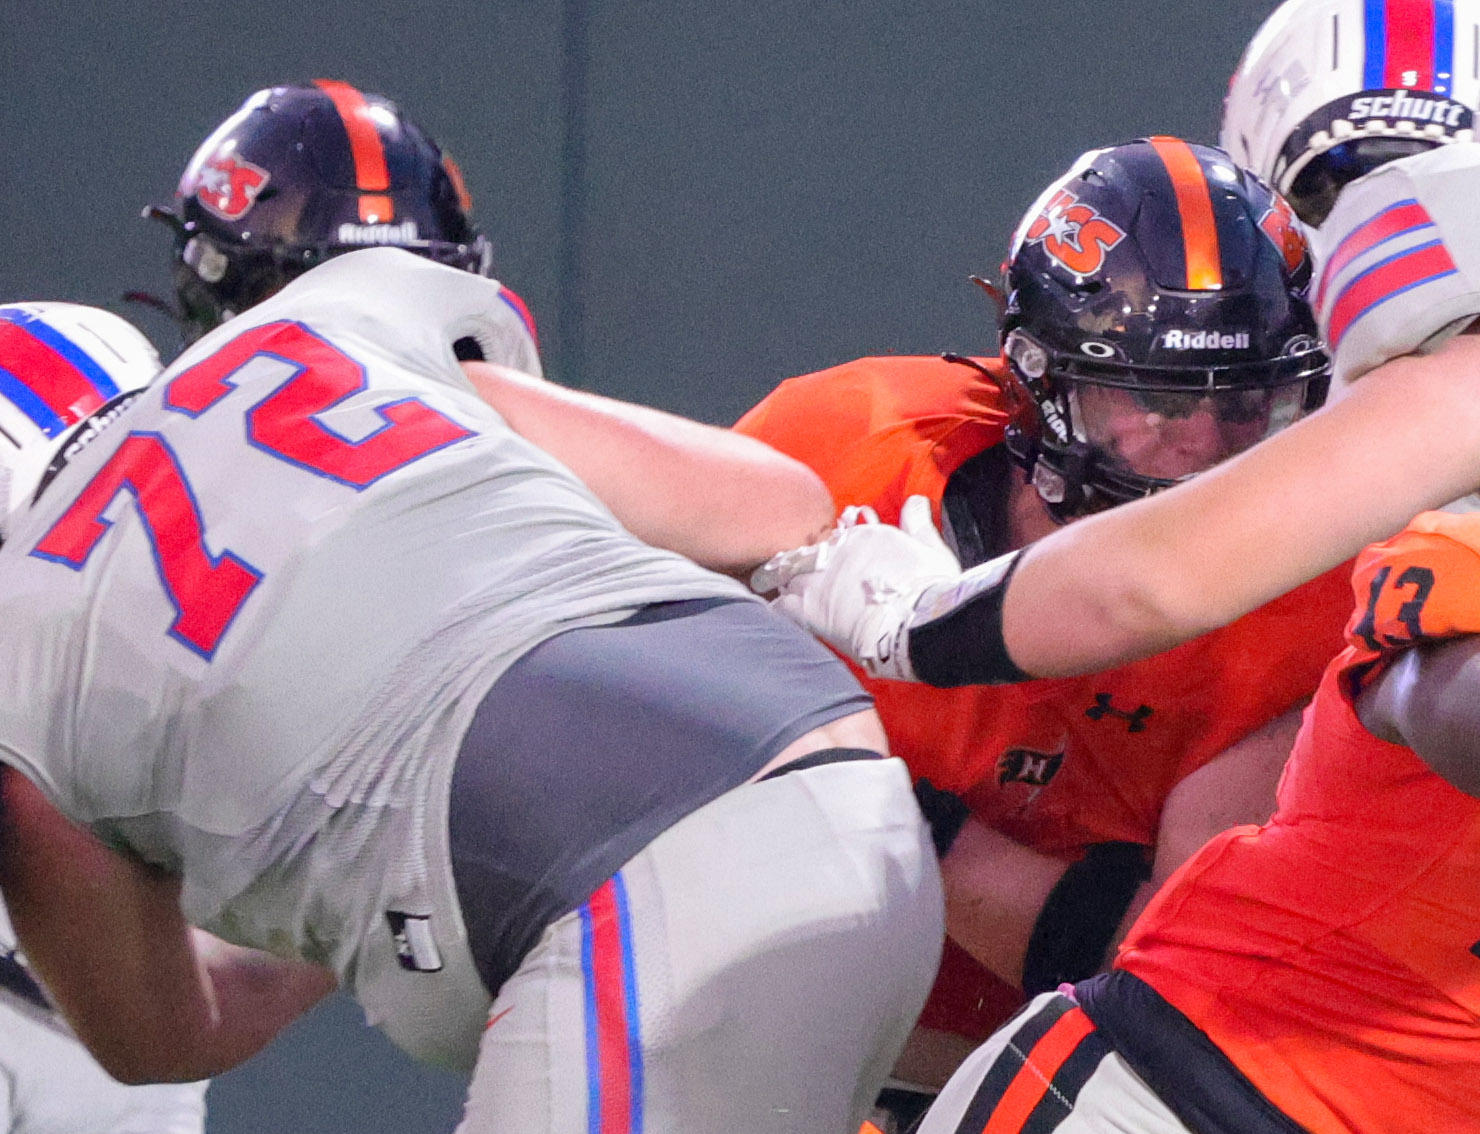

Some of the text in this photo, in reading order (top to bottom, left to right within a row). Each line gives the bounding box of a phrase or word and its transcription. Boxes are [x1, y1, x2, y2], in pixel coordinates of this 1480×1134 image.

[1348, 89, 1464, 127] schutt
[1161, 329, 1250, 350] Riddell
[30, 319, 481, 663] 72
